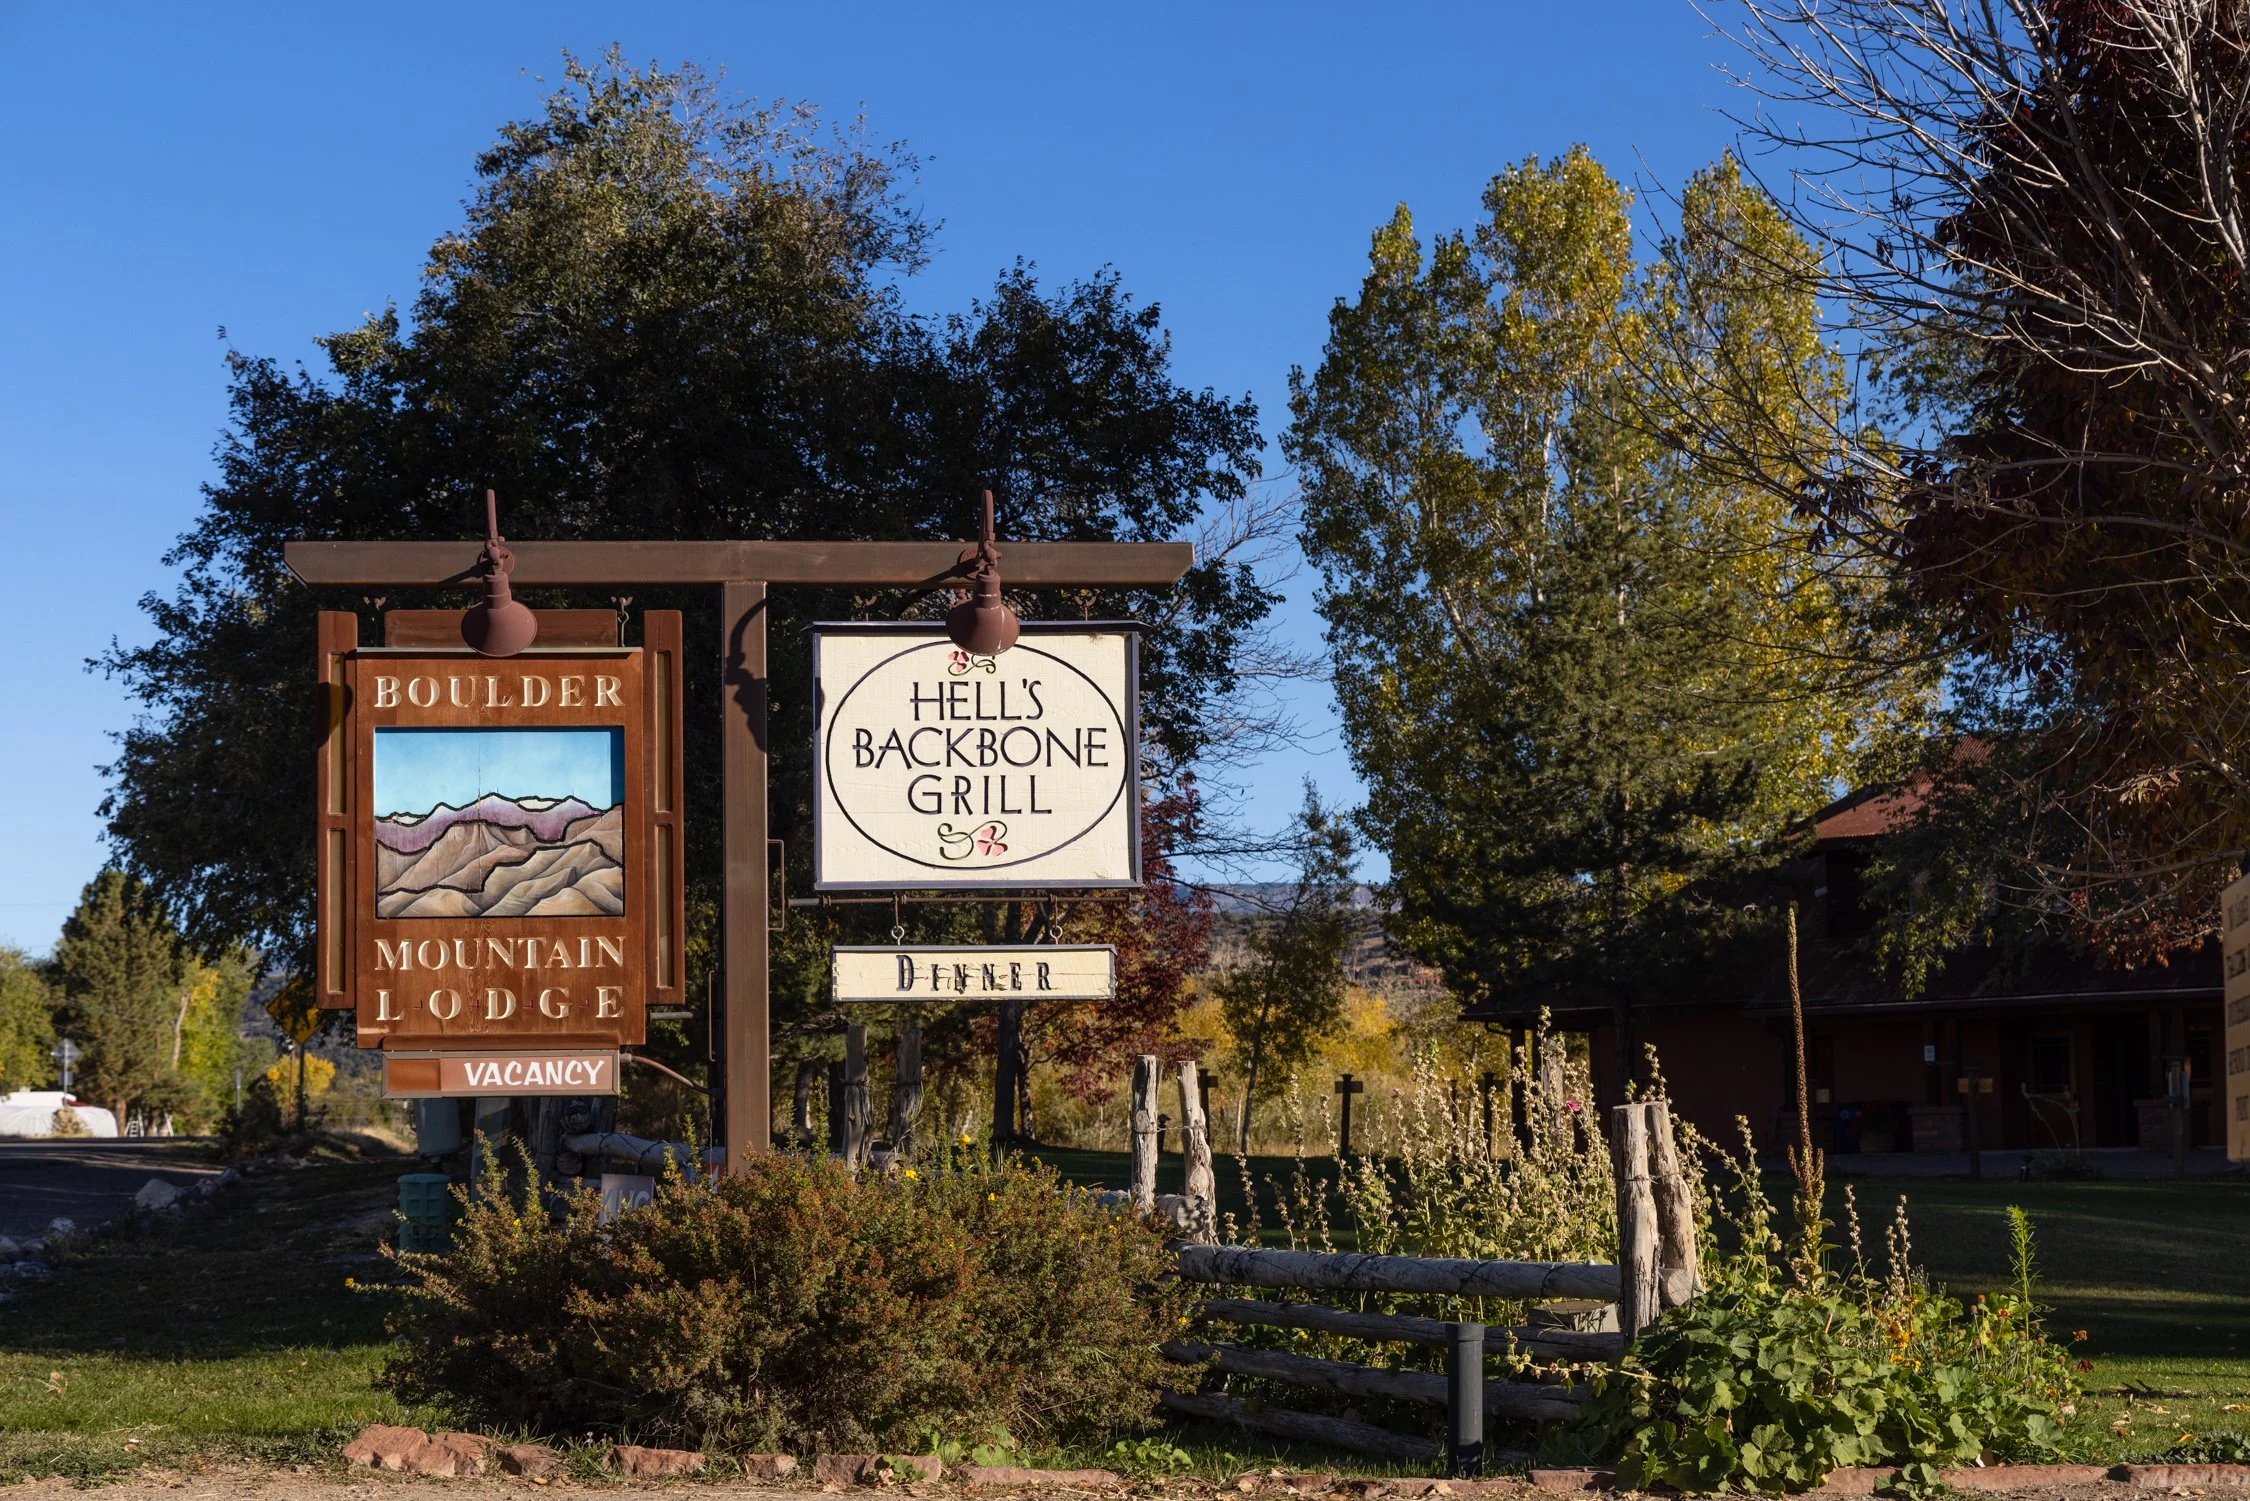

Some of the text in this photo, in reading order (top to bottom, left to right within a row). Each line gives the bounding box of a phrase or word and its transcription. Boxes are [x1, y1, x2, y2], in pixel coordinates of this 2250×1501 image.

[373, 675, 625, 708] BOULDER
[909, 678, 1044, 722] HELL'S
[852, 726, 1109, 769] BACKBONE
[907, 774, 1052, 816] GRILL
[374, 936, 626, 972] MOUNTAIN
[895, 954, 1052, 994] DINNER
[376, 985, 625, 1022] LODGE
[463, 1059, 605, 1087] VACANCY
